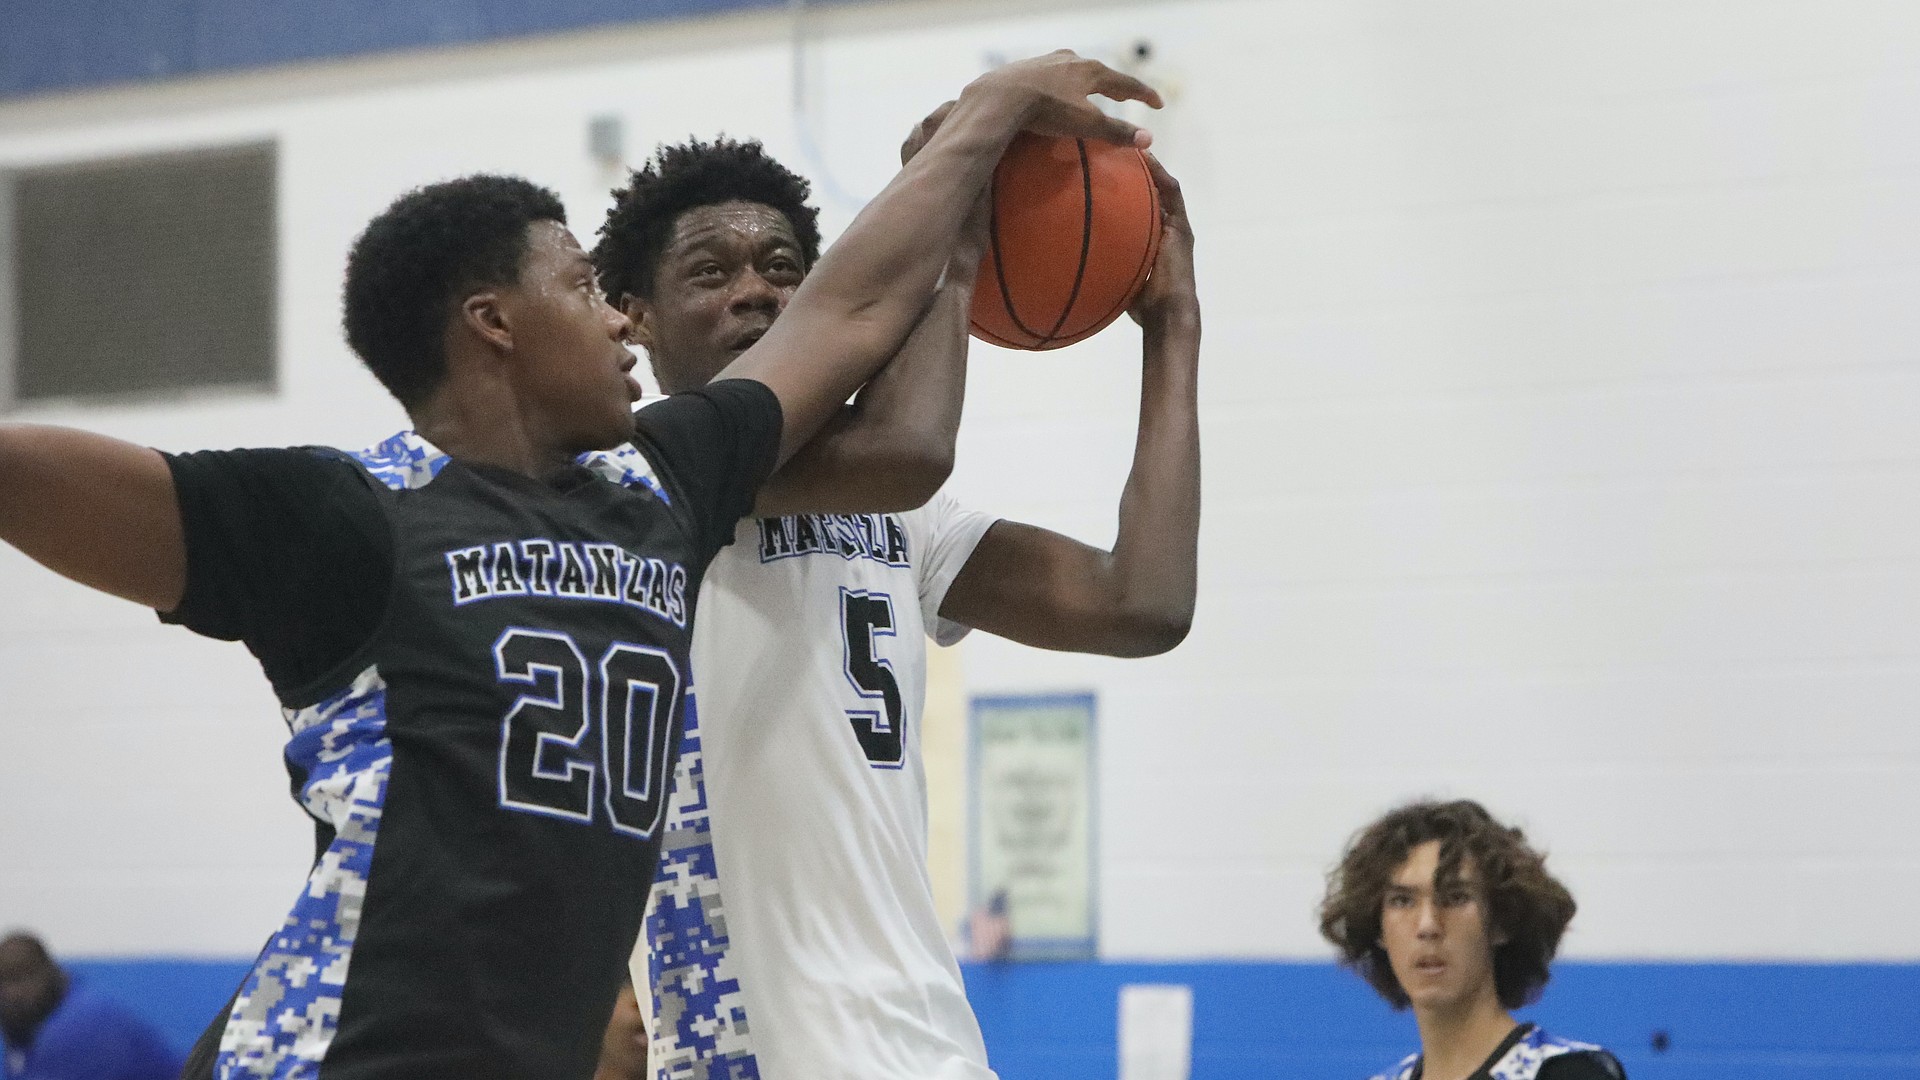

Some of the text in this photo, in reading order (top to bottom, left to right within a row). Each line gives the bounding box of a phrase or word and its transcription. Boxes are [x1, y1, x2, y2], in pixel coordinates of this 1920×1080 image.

[446, 538, 687, 629] MATANZAS
[493, 627, 681, 841] 20
[838, 585, 907, 770] 5
